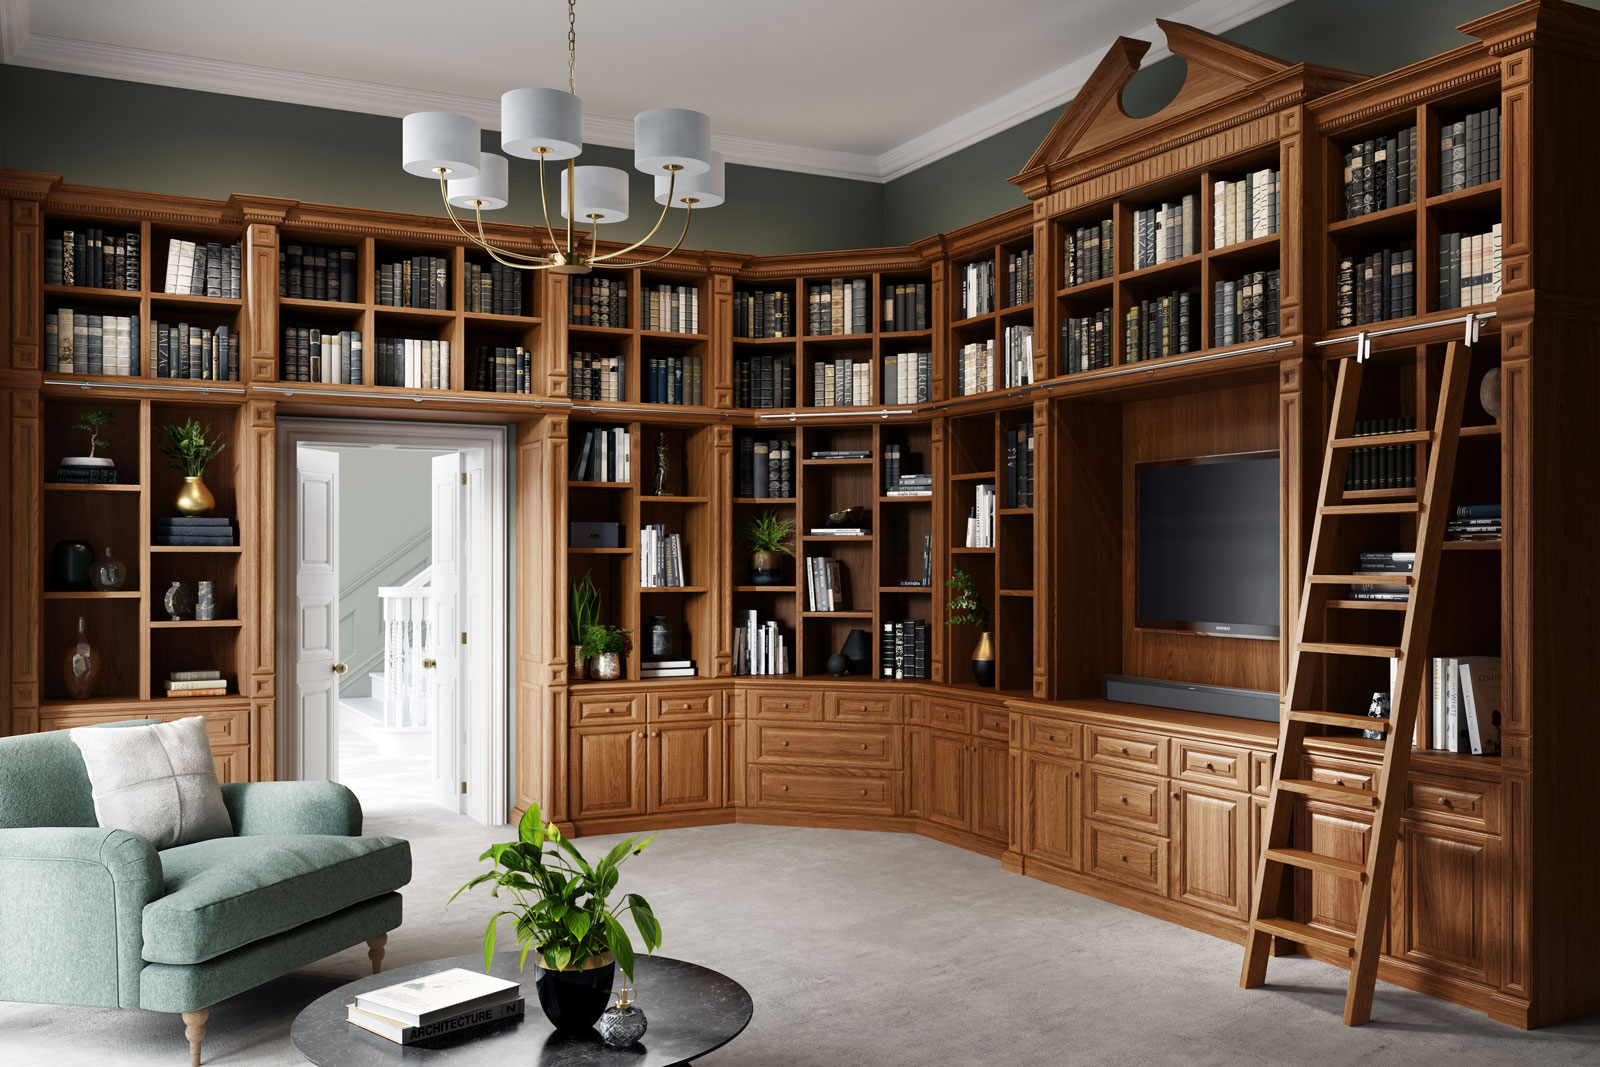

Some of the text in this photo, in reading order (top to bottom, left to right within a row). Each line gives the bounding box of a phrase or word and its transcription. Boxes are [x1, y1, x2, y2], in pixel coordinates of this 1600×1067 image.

[159, 330, 168, 371] BALZAC
[836, 366, 844, 402] DUMAS
[410, 1009, 492, 1040] ARCHITECTURE
